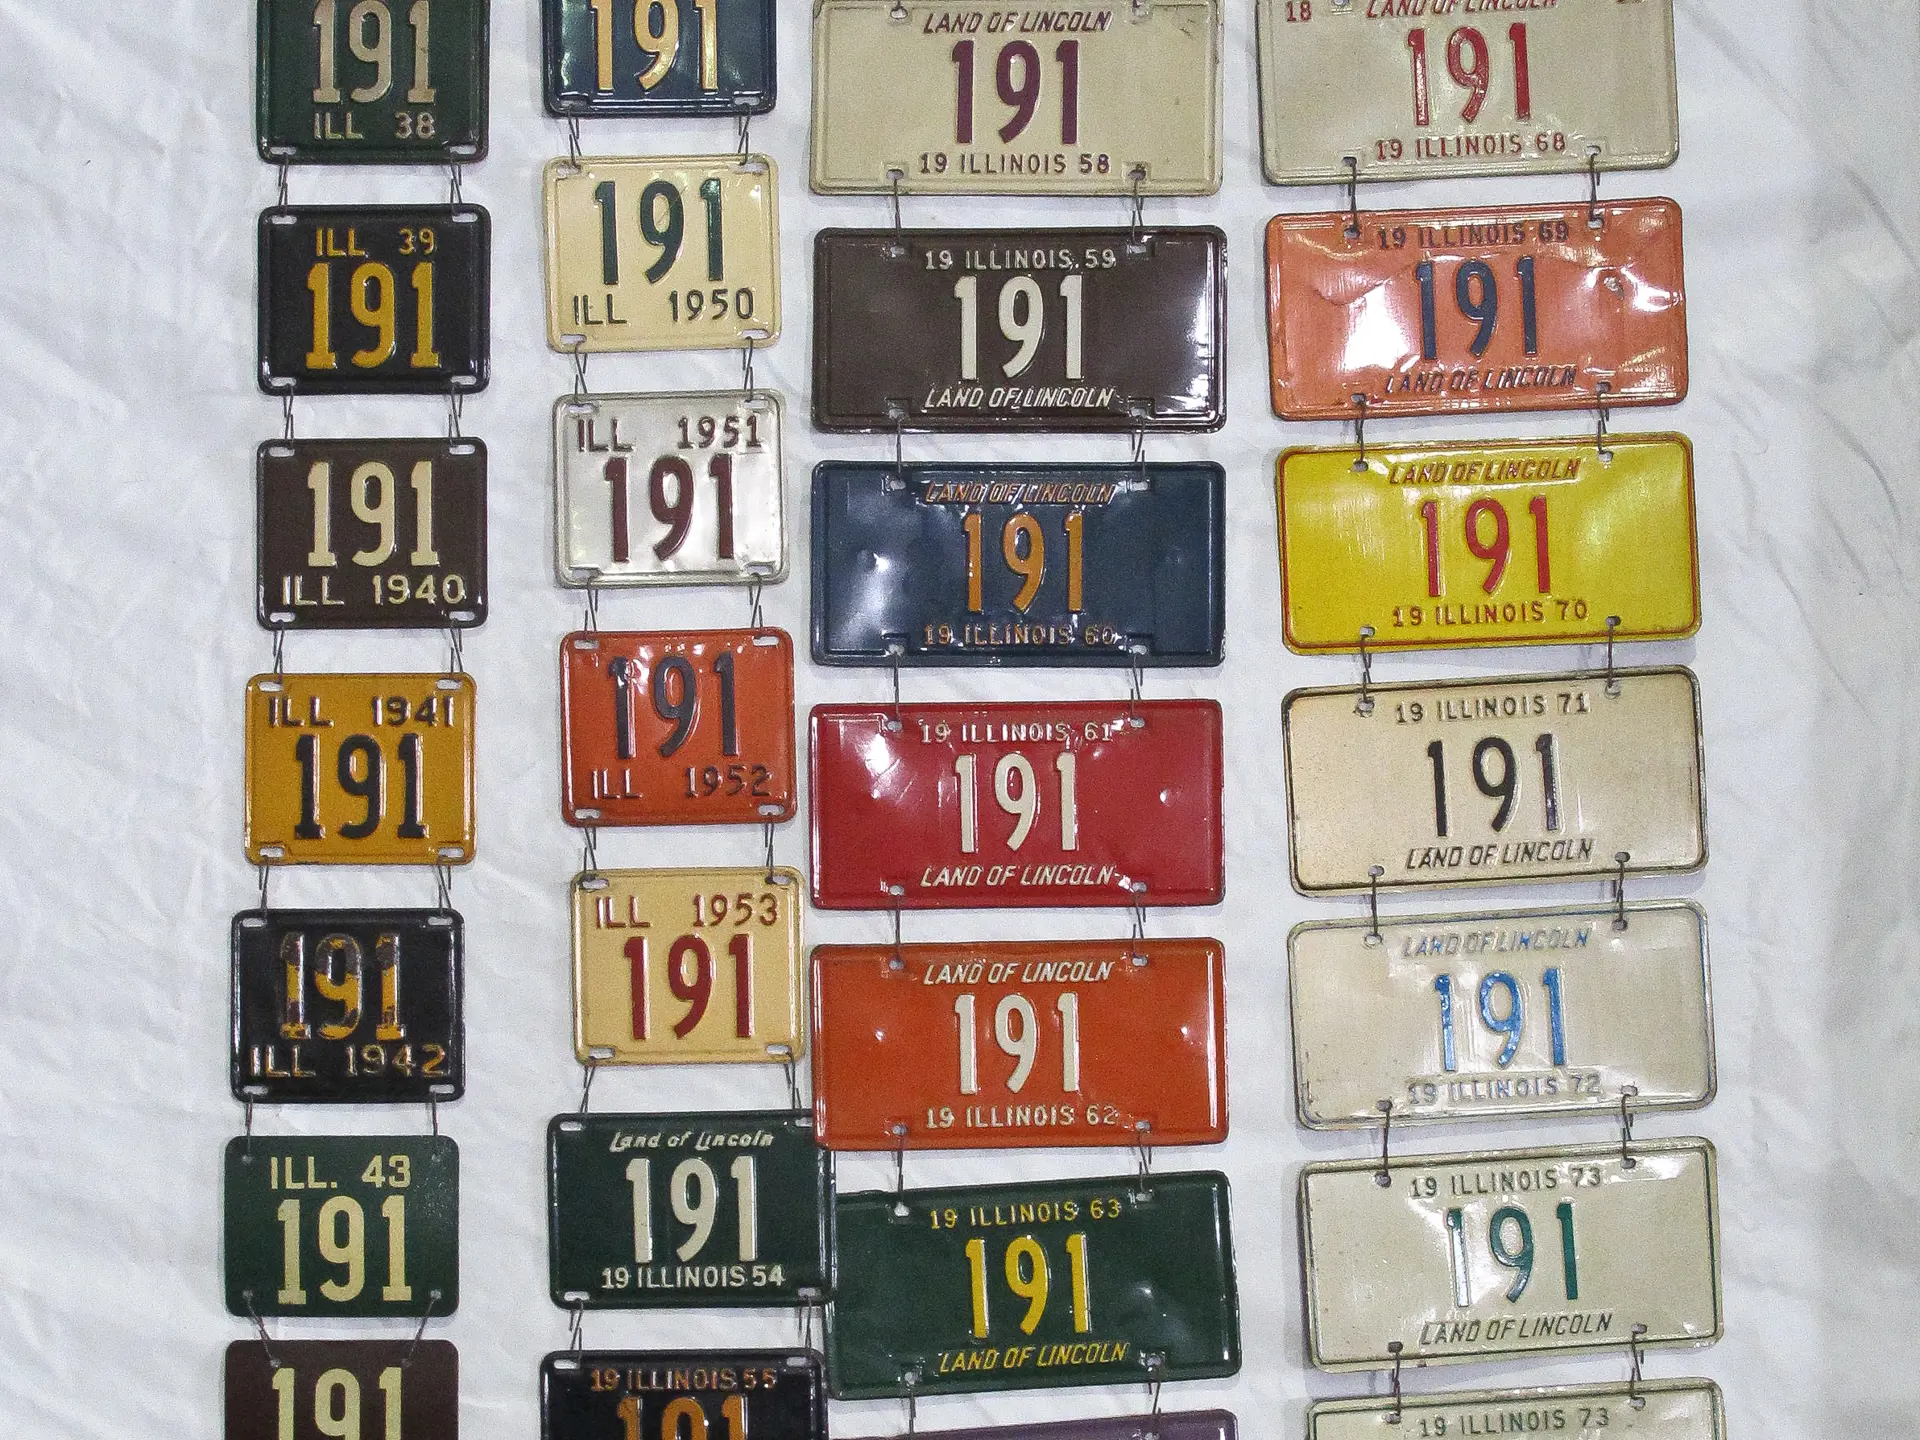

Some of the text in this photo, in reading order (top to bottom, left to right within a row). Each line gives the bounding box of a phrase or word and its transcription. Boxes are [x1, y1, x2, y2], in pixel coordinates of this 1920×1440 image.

[923, 11, 1113, 33] LAND OF LINCOLN
[1286, 1, 1311, 22] 18
[1367, 0, 1426, 18] LAND
[313, 0, 435, 104] 191
[589, 0, 718, 93] 191
[1407, 22, 1531, 126] 191
[952, 39, 1079, 145] 191
[314, 112, 435, 140] ILL 38
[1376, 132, 1566, 160] 19 ILLINOIS 68
[920, 153, 1110, 175] 19 ILLINOIS 58
[316, 228, 435, 257] ILL 39
[595, 178, 723, 285] 191
[1378, 220, 1570, 249] 19 ILLINOIS 69
[925, 249, 1116, 271] 19 ILLINOIS 59
[306, 261, 439, 369] 191
[574, 288, 754, 325] ILL 1950
[1415, 256, 1538, 361] 191
[953, 274, 1083, 381] 191
[1386, 366, 1578, 394] LAND OF LINCOLN
[925, 388, 1116, 409] LAND OF LINCOLN
[577, 416, 761, 453] ILL 1951
[1389, 457, 1581, 484] LAND OF LINCOLN
[604, 454, 734, 563] 191
[925, 482, 1115, 503] LAND OF LINCOLN
[308, 461, 439, 567] 191
[1421, 495, 1551, 597] 191
[963, 512, 1083, 613] 191
[282, 575, 466, 605] ILL 1940
[1393, 598, 1588, 628] 19 ILLINOIS 70
[924, 624, 1115, 646] 19 ILLINOIS 60
[268, 696, 455, 727] ILL 1941
[608, 651, 738, 759] 191
[1395, 693, 1589, 723] 19 ILLINOIS 71
[921, 720, 1112, 743] 19 ILLINOIS 61
[295, 733, 428, 840] 191
[591, 765, 775, 799] ILL 1952
[1428, 733, 1558, 837] 191
[955, 751, 1078, 853] 191
[1406, 839, 1594, 869] LAND OF LINCOLN
[921, 865, 1113, 887] LAND OF LINCOLN
[596, 893, 778, 929] ILL 1953
[1402, 928, 1592, 958] LAND OF LINCOLN
[280, 932, 405, 1040] 191
[623, 934, 755, 1040] 191
[923, 962, 1113, 985] LAND OF LINCOLN
[1434, 967, 1565, 1072] 191
[954, 992, 1079, 1094] 191
[250, 1044, 447, 1077] ILL 1942
[1409, 1074, 1601, 1105] 19 ILLINOIS 72
[926, 1104, 1118, 1129] 19 ILLINOIS 62
[610, 1130, 774, 1153] Land of Lincoln
[271, 1155, 411, 1189] ILL. 43
[1410, 1167, 1602, 1198] 19 ILLINOIS 73
[626, 1156, 757, 1264] 191
[930, 1199, 1121, 1230] 19 ILLINOIS 63
[277, 1195, 411, 1305] 191
[1446, 1202, 1578, 1308] 191
[602, 1267, 785, 1289] 19 ILLINOIS 54
[965, 1232, 1092, 1339] 191
[1421, 1313, 1613, 1346] LAND OF LINCOLN
[938, 1342, 1129, 1373] LAND OF LINCOLN
[591, 1369, 777, 1391] 19 ILLINOIS 55
[271, 1366, 402, 1440] 191
[1419, 1407, 1610, 1438] 19 ILLINOIS 73
